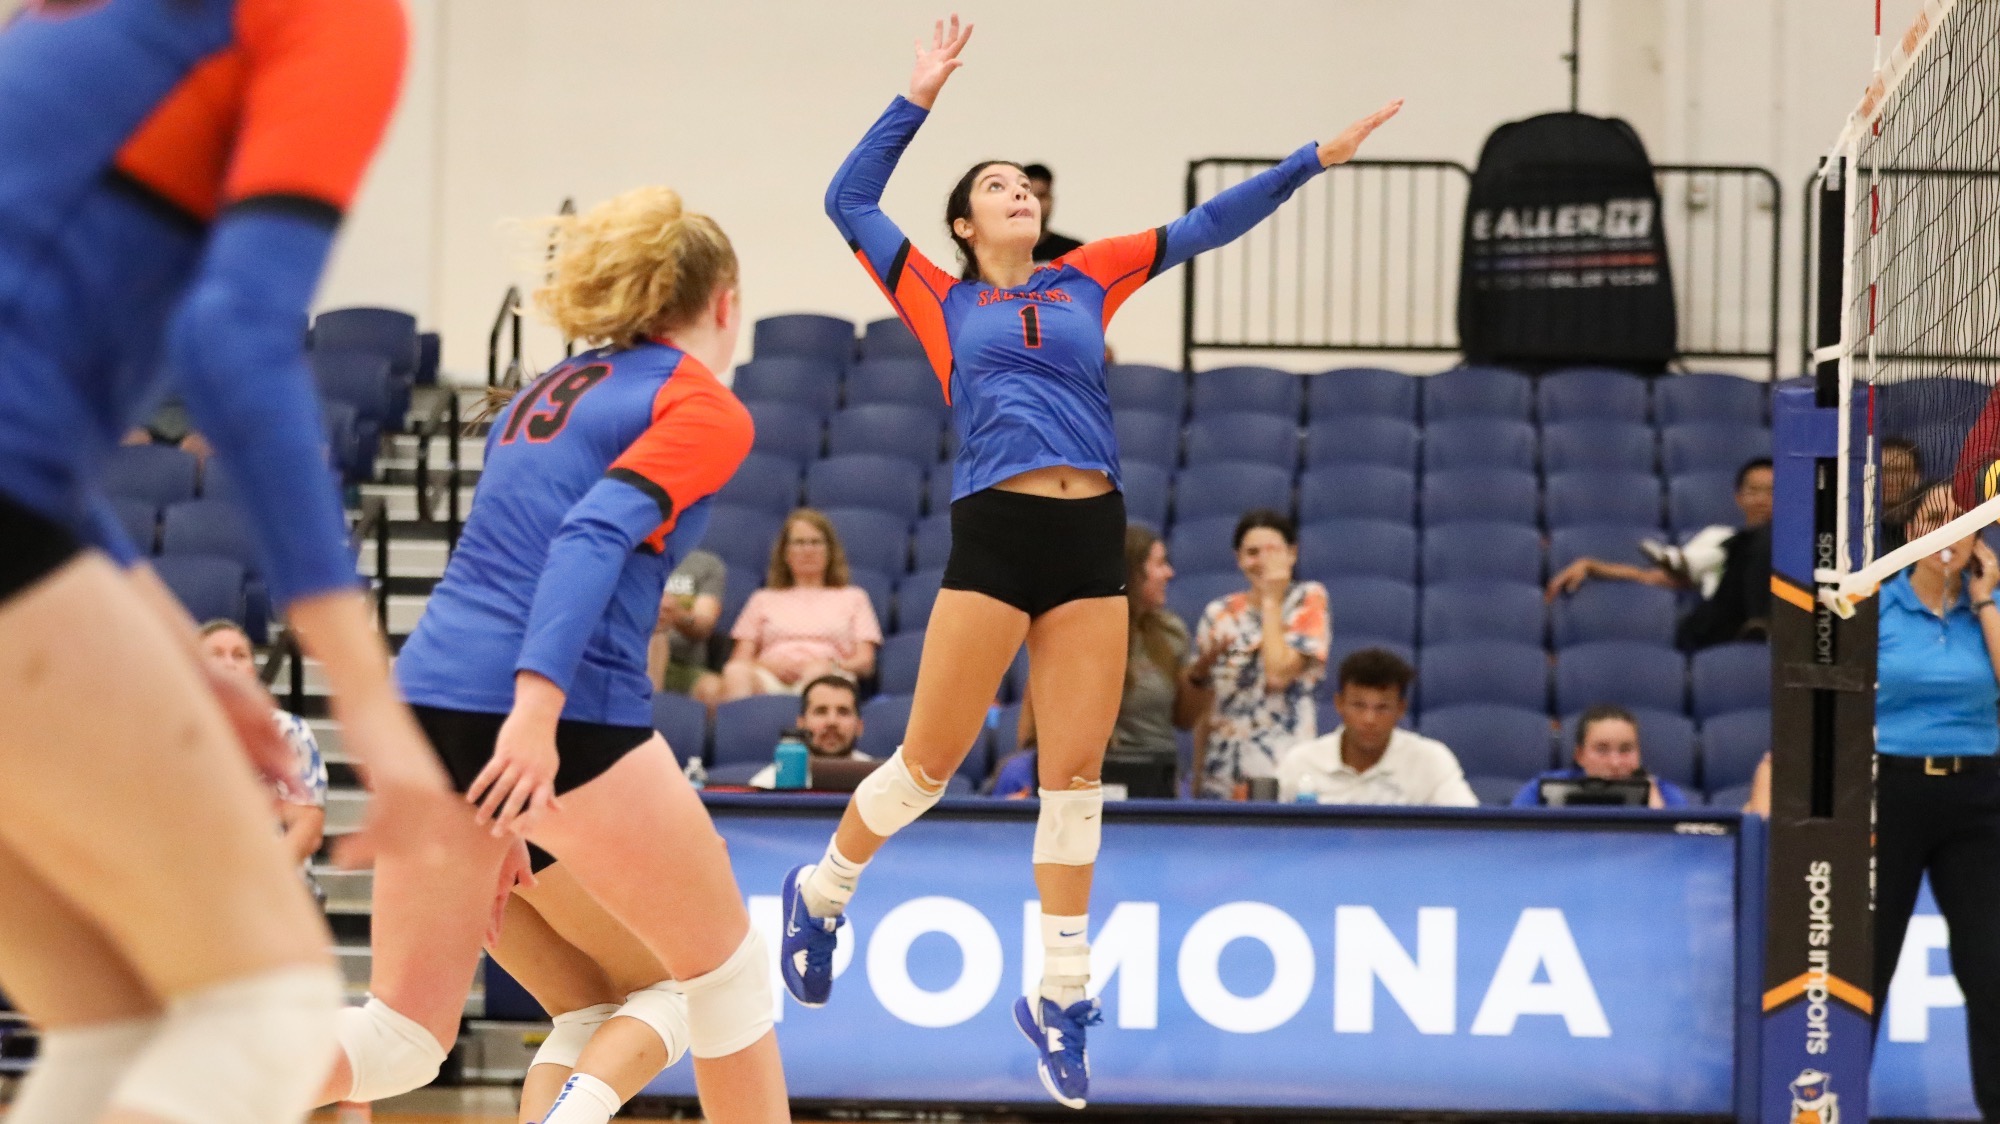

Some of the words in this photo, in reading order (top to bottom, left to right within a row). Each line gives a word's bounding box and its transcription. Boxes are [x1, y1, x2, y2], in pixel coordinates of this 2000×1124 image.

[1018, 303, 1042, 348] 1
[501, 363, 613, 446] 19
[1805, 861, 1832, 947] sports
[1803, 950, 1831, 1054] imports
